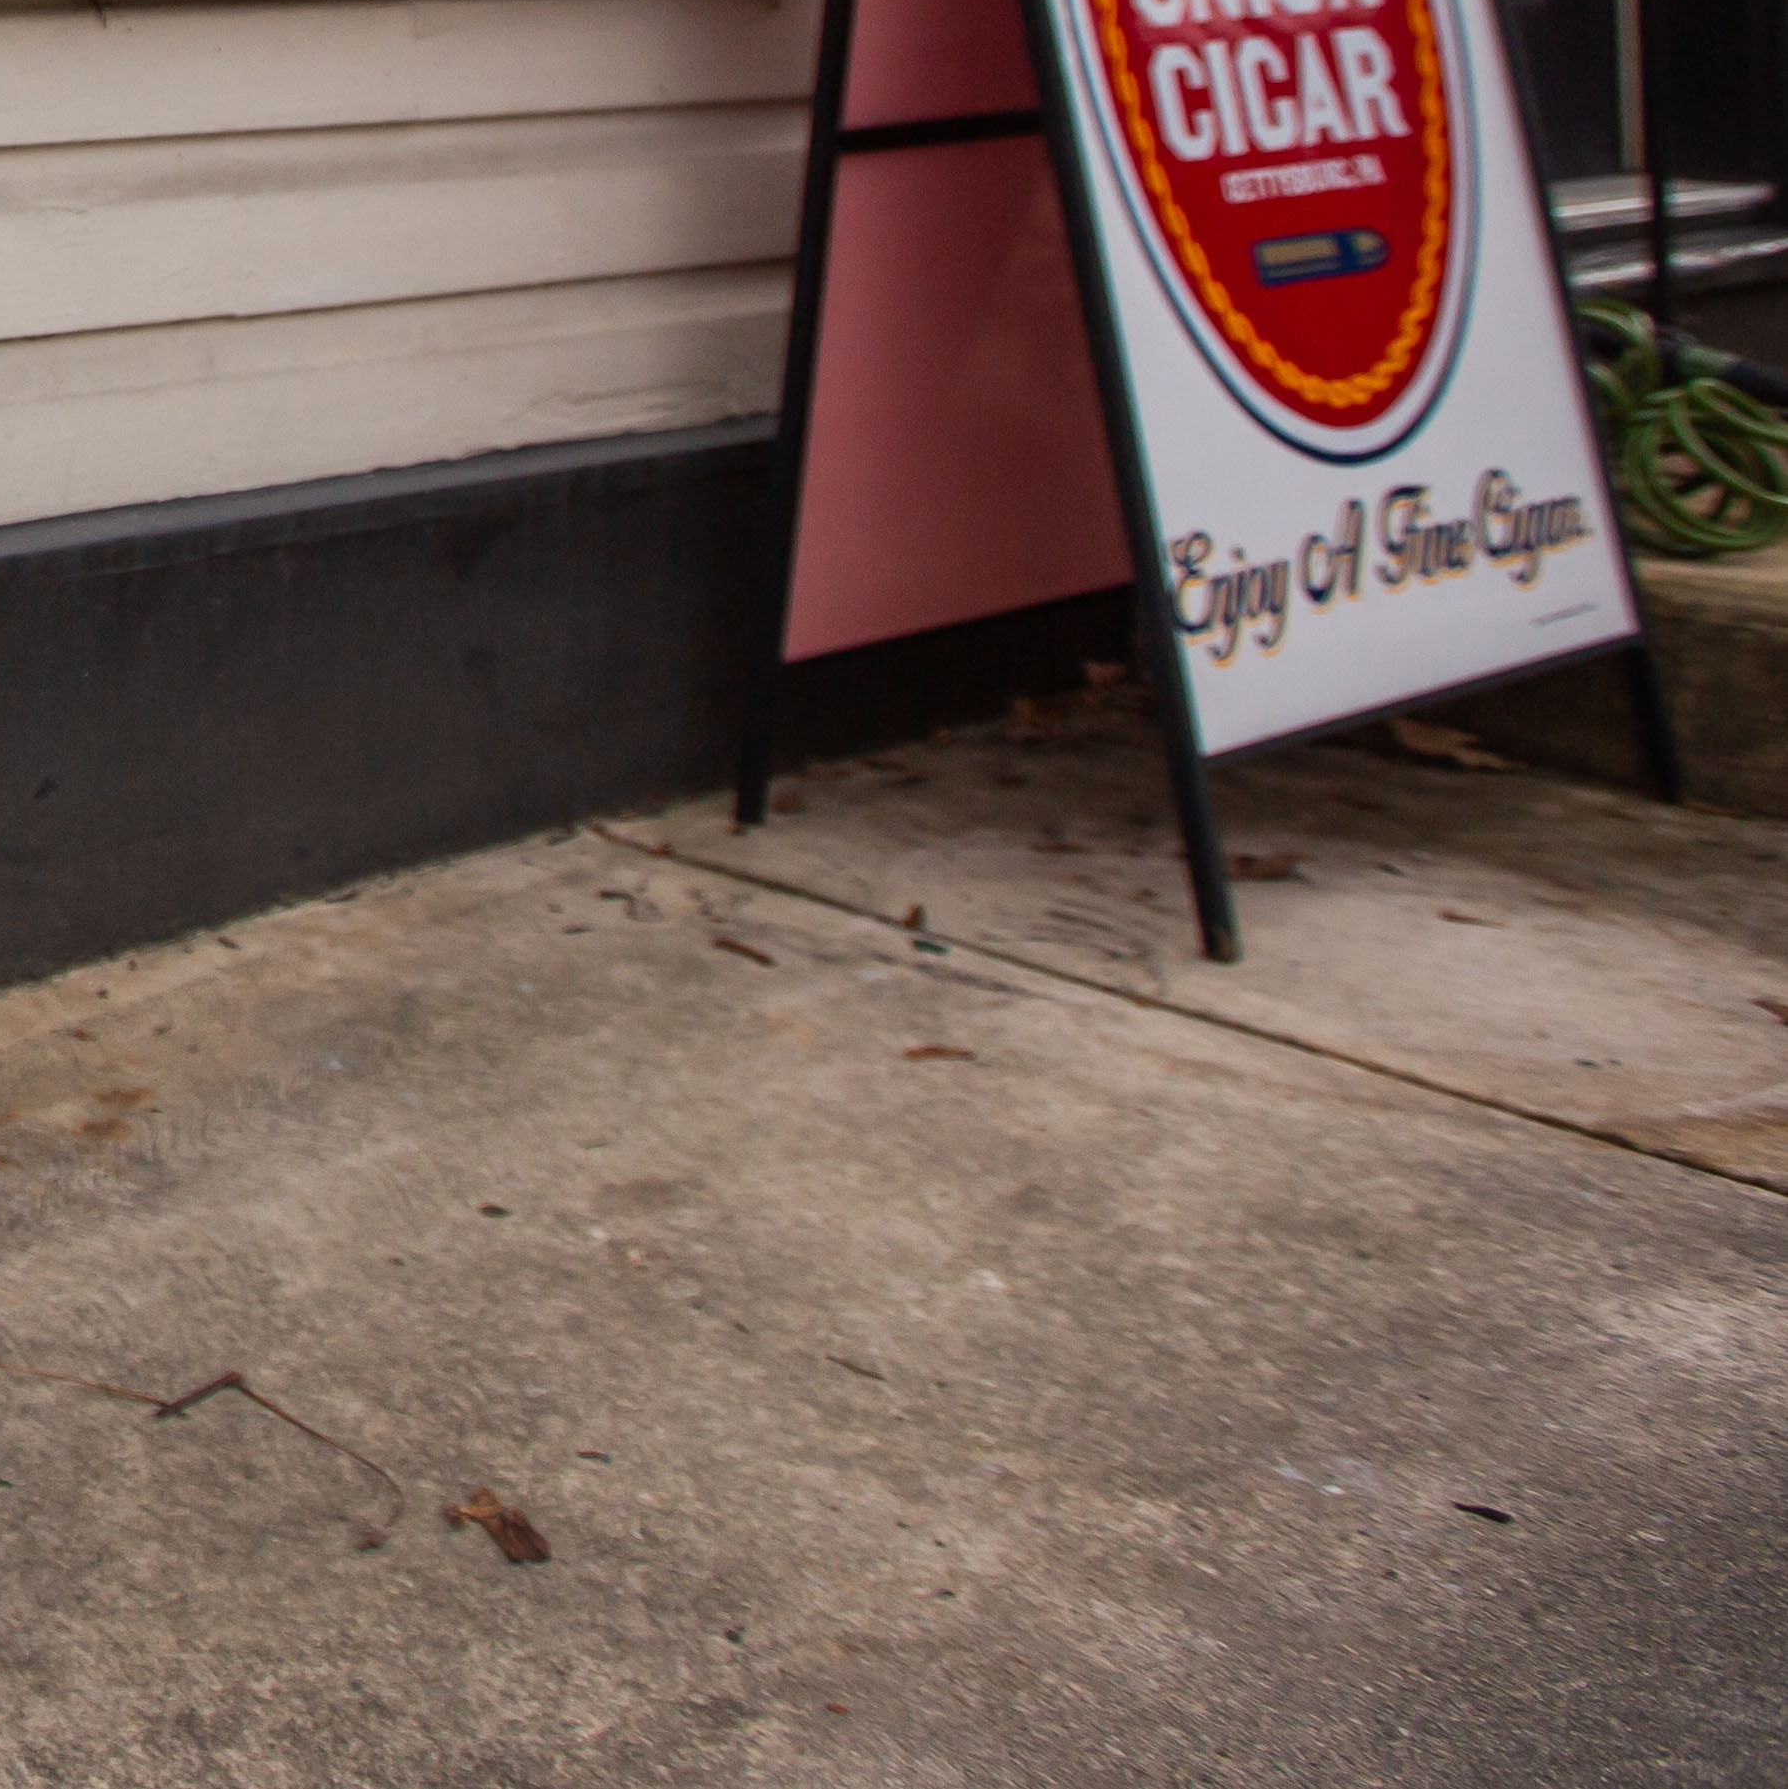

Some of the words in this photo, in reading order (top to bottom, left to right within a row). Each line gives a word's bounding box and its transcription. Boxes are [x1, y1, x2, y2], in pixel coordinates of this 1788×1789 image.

[1147, 27, 1411, 162] CIGAR
[1169, 529, 1291, 668] Enjoy
[1300, 498, 1364, 613] A
